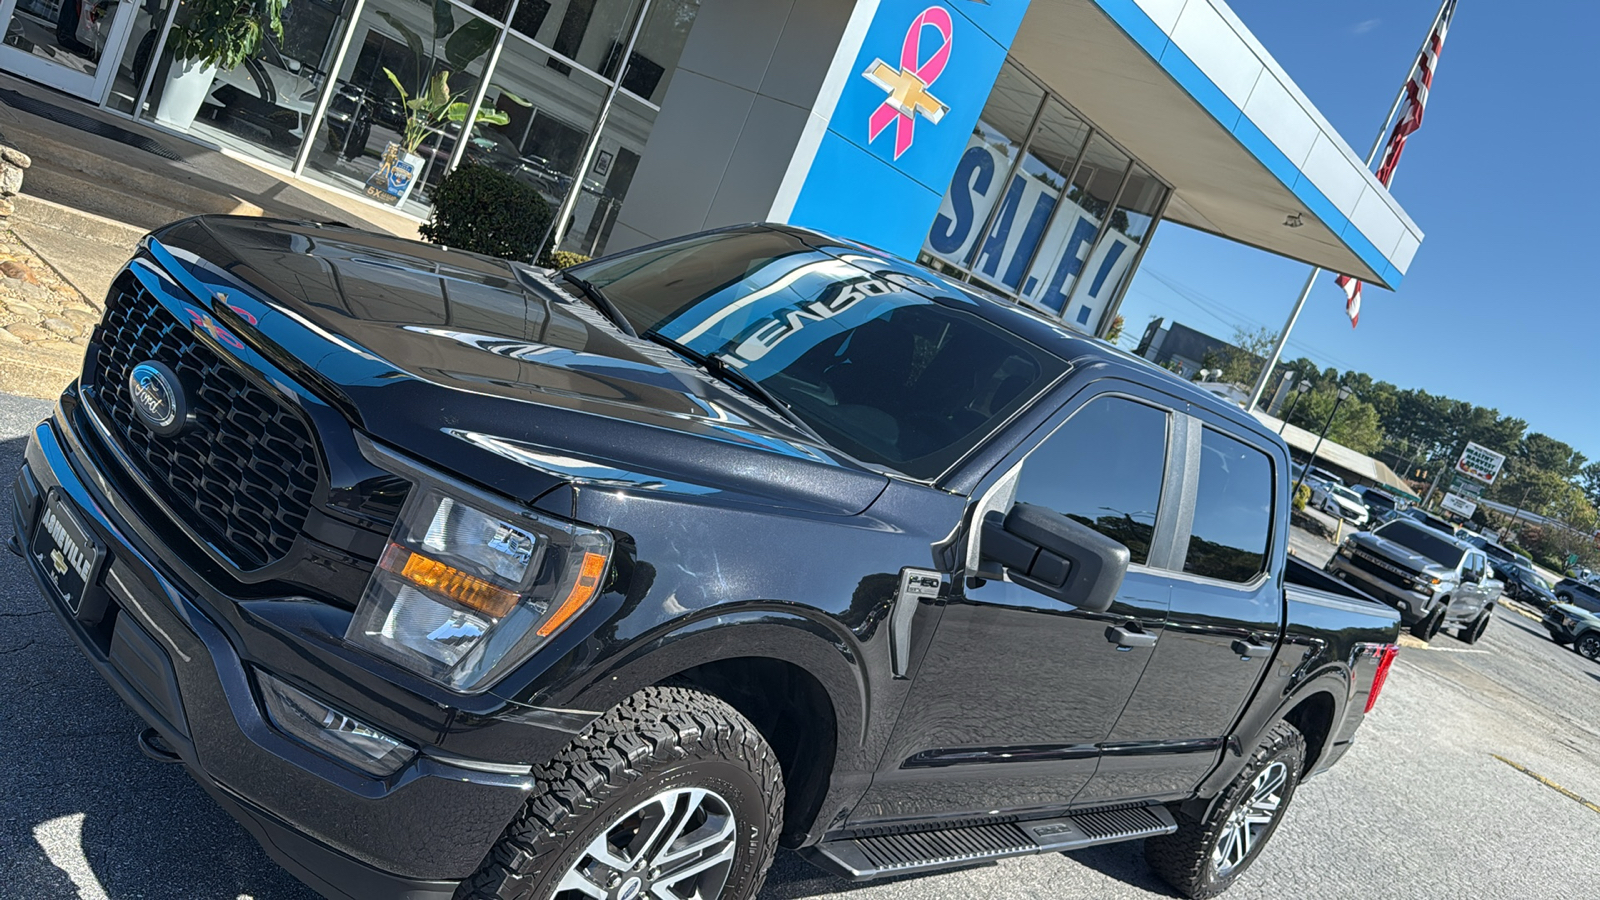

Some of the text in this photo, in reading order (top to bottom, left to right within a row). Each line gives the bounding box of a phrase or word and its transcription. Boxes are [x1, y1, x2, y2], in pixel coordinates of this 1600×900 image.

[929, 146, 1127, 326] SALE!
[134, 376, 161, 413] Ford
[1465, 447, 1495, 463] HEALTHY
[1465, 454, 1496, 470] HARVEST
[1465, 460, 1497, 476] PRODUCE
[41, 508, 92, 583] ASHEVILLE
